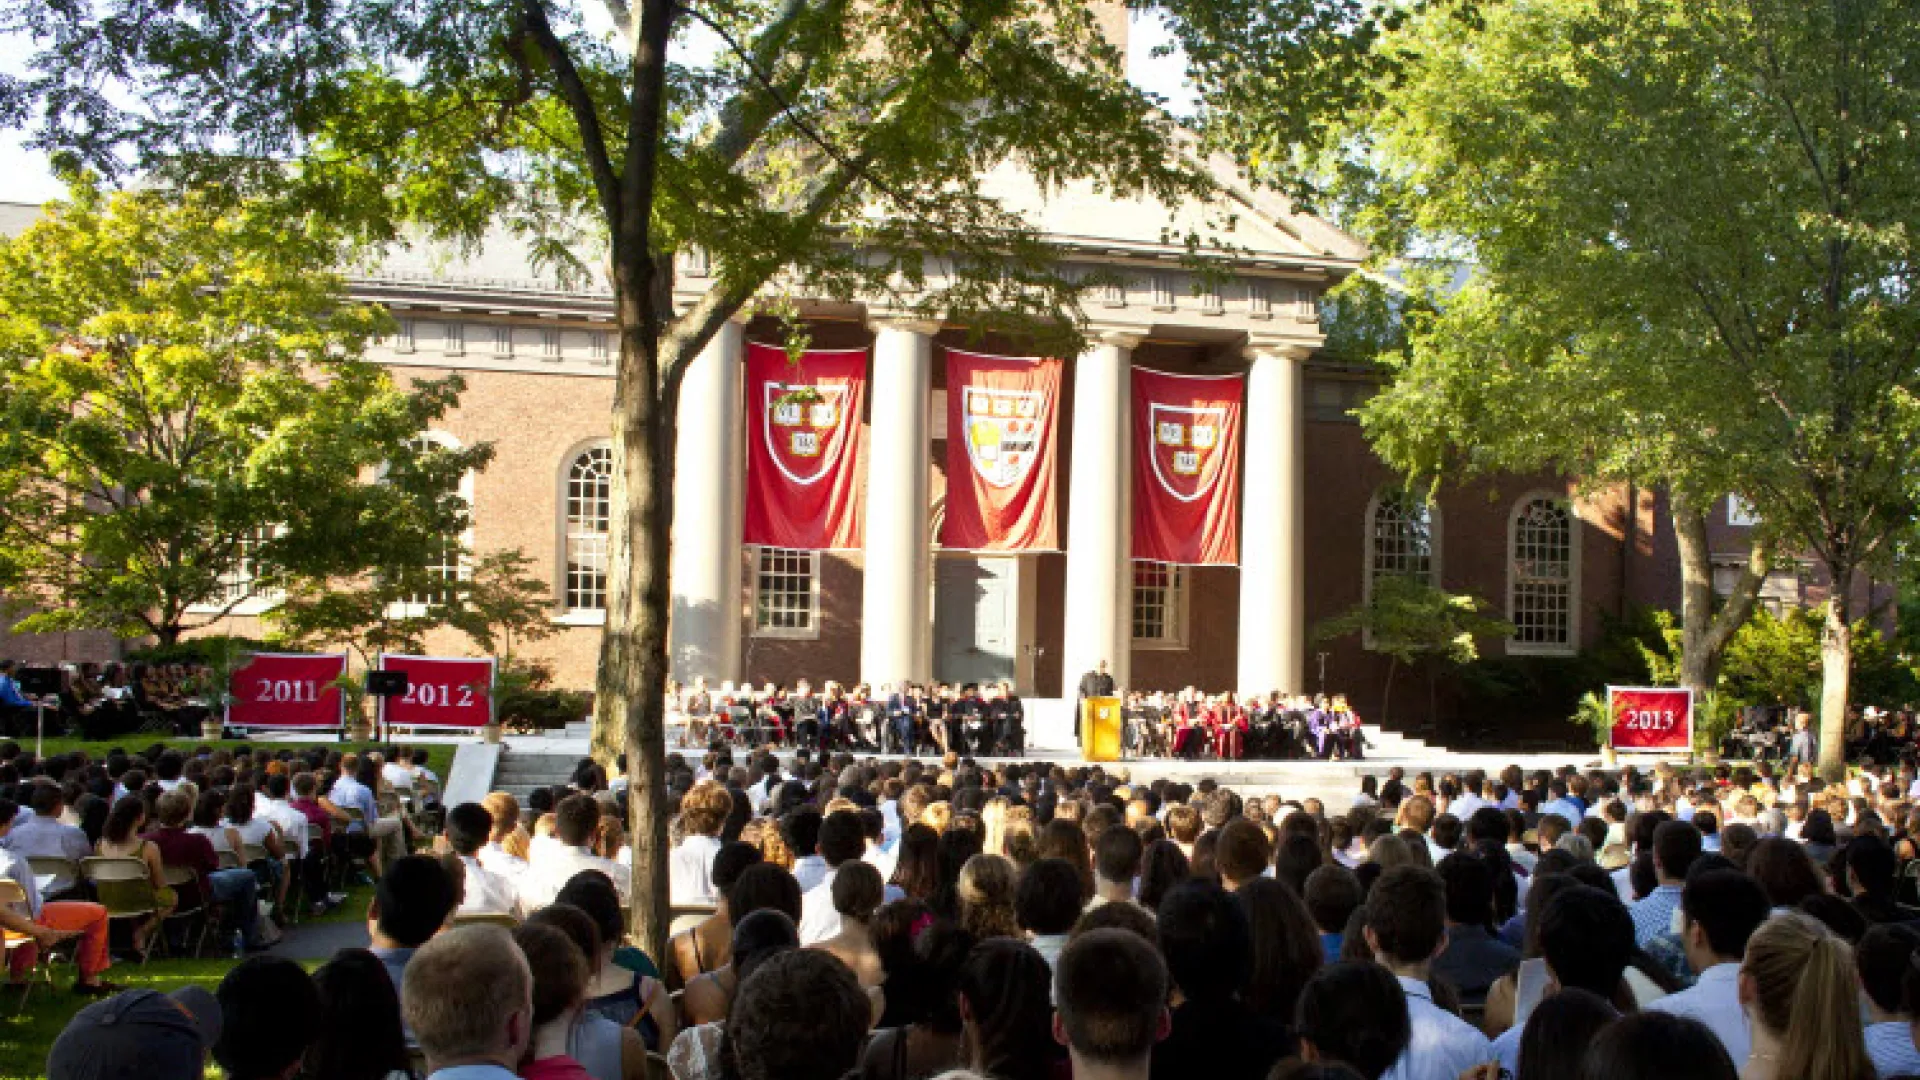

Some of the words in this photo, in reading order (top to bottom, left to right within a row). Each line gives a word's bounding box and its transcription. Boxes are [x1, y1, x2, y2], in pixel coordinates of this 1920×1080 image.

[256, 678, 317, 702] 2011
[401, 682, 474, 706] 2012
[1626, 708, 1674, 731] 2013
